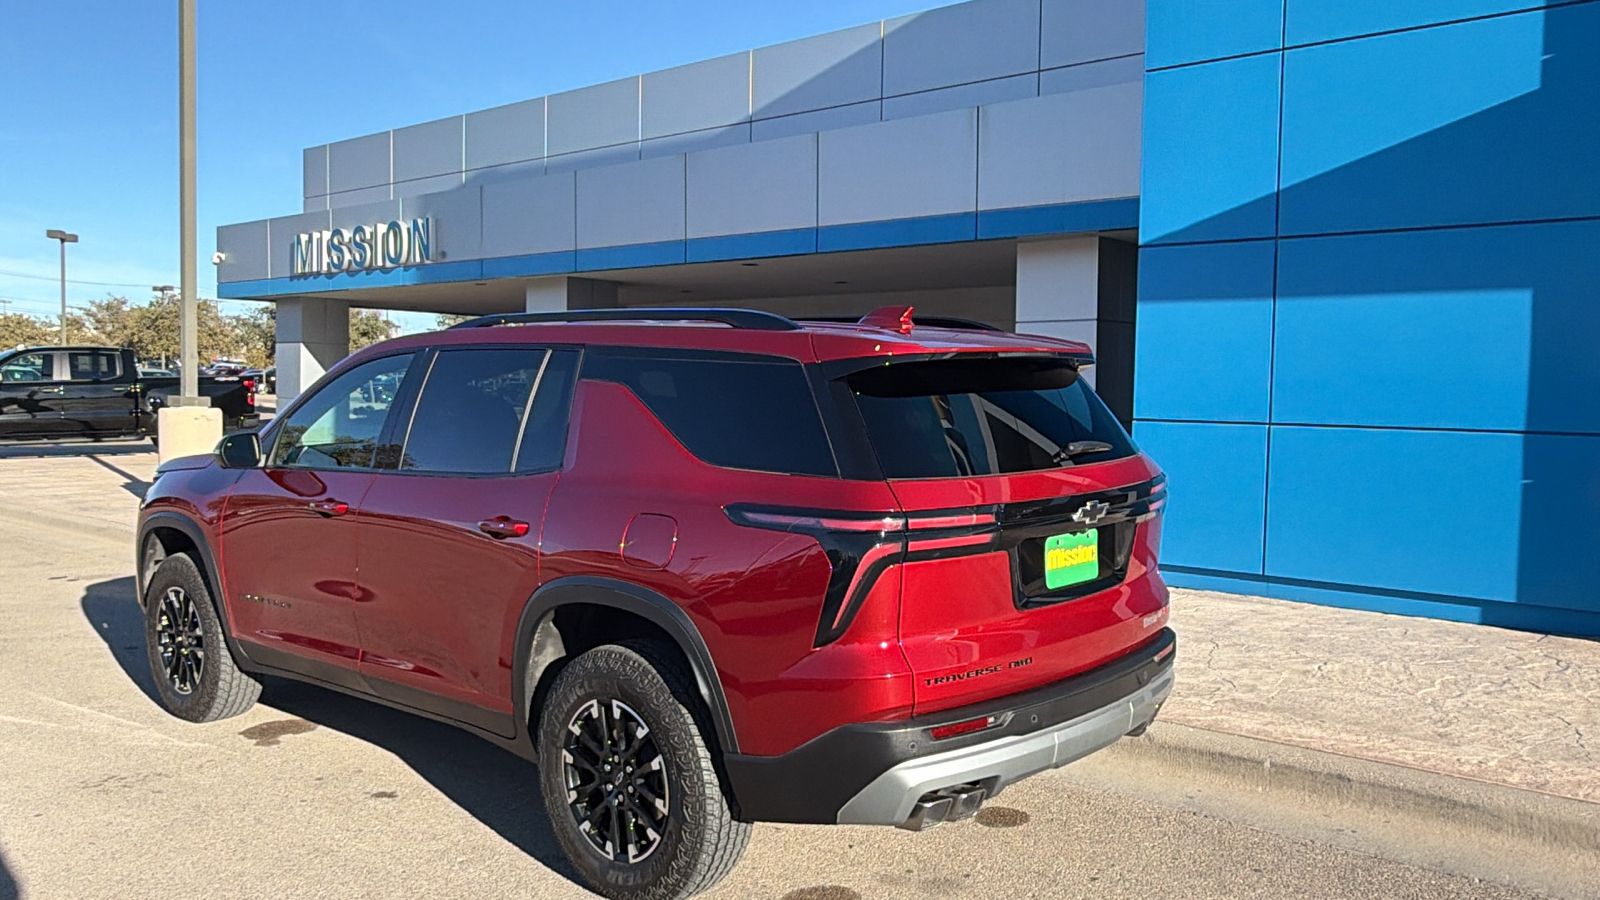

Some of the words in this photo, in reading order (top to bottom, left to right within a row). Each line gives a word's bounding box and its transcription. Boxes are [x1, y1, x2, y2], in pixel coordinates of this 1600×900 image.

[294, 217, 434, 273] MISSION
[924, 664, 1002, 686] TRAVERSE
[1008, 656, 1033, 669] AWD
